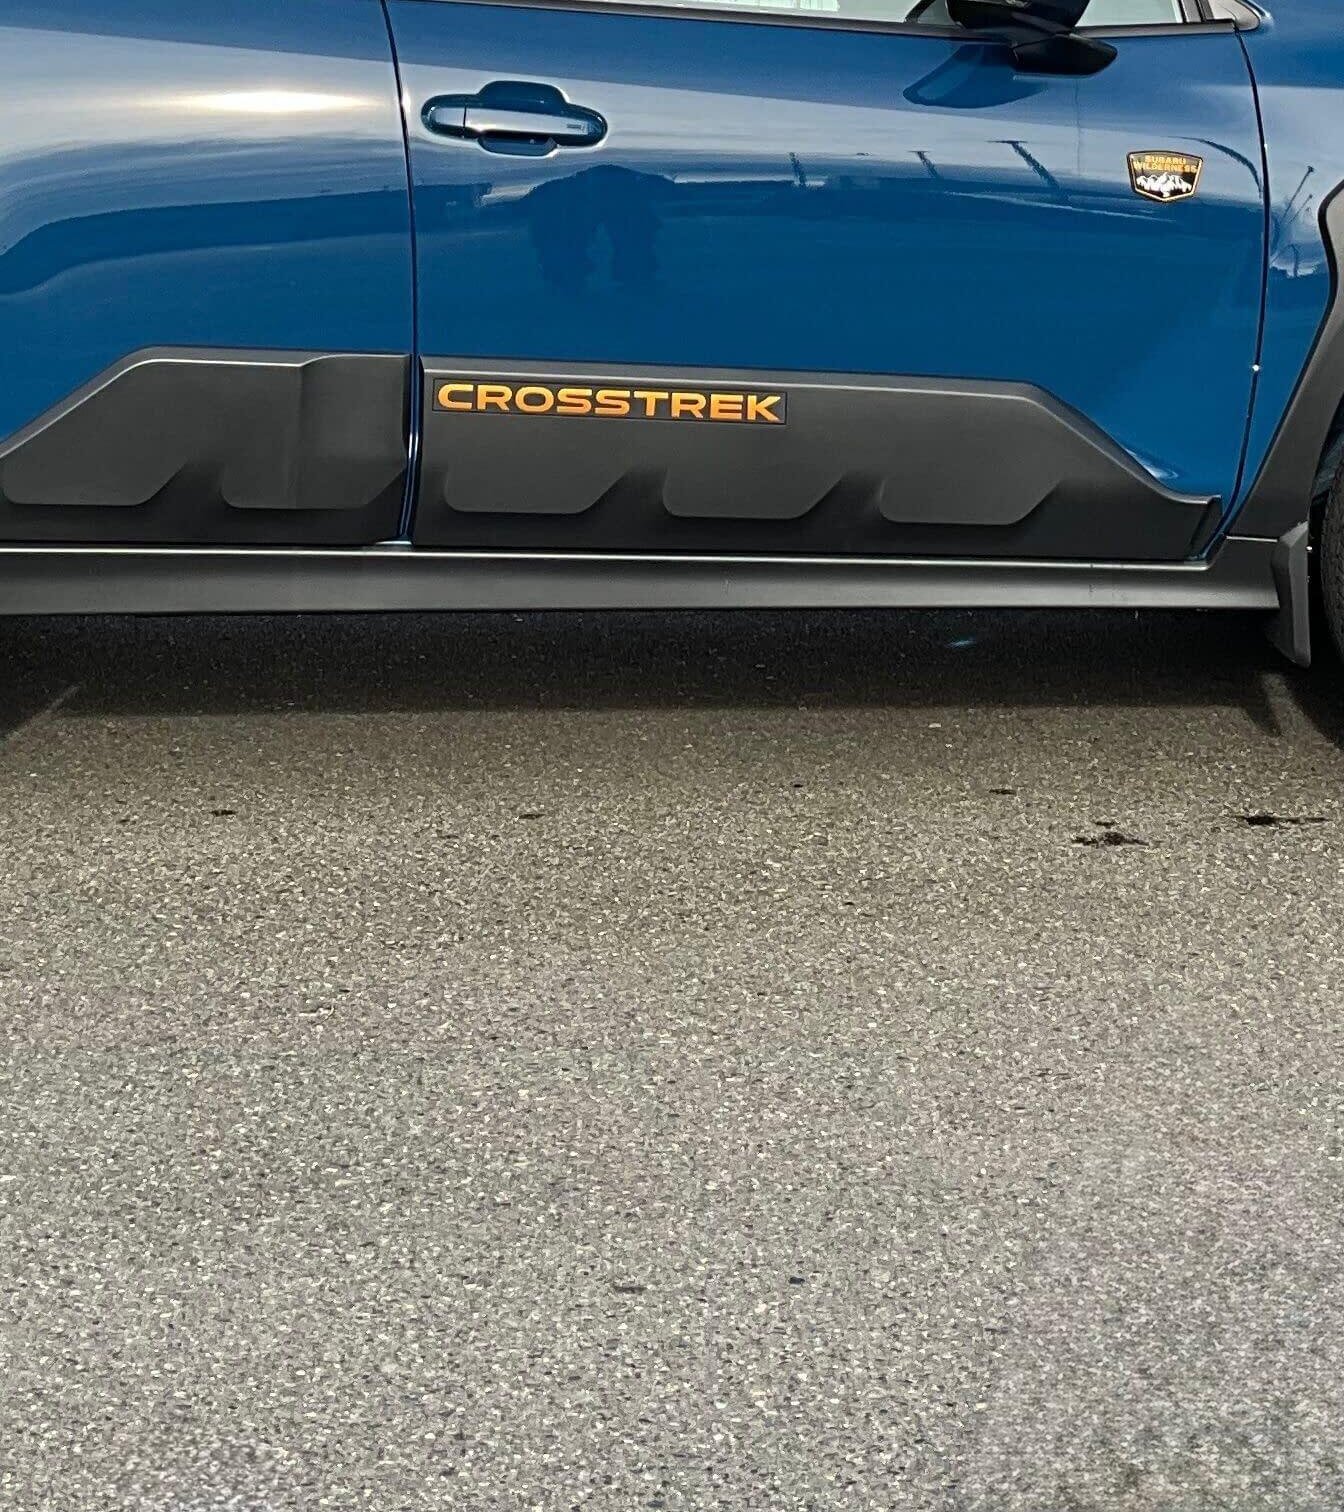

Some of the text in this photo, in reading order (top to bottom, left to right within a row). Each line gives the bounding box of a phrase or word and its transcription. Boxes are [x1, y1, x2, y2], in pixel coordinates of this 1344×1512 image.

[1145, 155, 1187, 165] SUBARU
[1133, 161, 1197, 173] WILDERNESS
[437, 383, 782, 421] CROSSTREK
